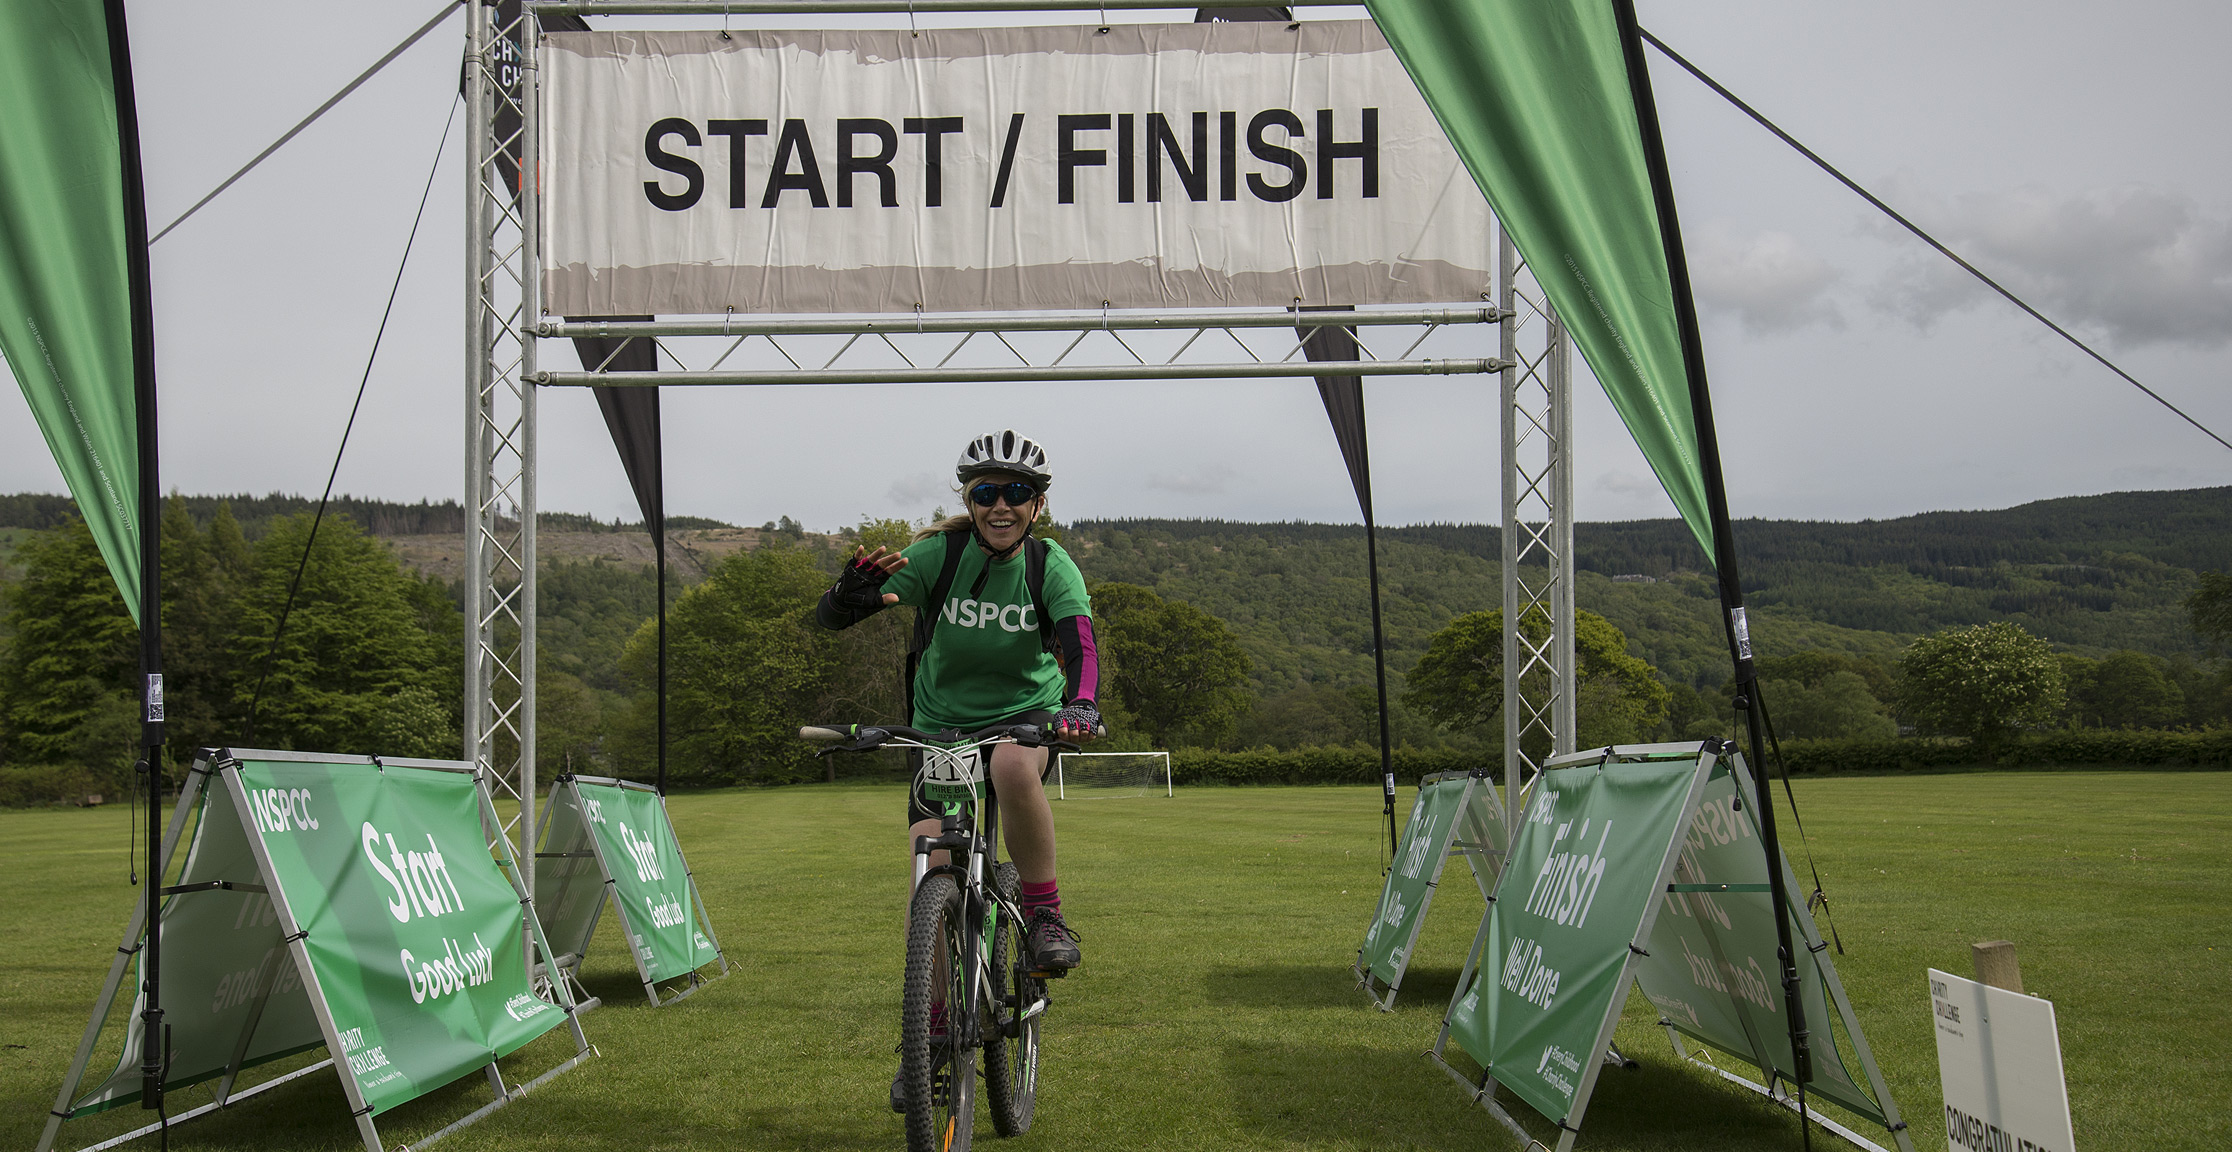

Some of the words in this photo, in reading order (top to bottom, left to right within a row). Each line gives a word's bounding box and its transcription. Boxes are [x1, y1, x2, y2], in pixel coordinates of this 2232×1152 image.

[643, 117, 964, 211] START
[990, 113, 1025, 208] /
[1057, 107, 1379, 205] FINISH
[45, 353, 61, 383] Registered
[1587, 290, 1608, 319] Registered
[1604, 317, 1618, 337] charity
[1616, 336, 1632, 359] England
[1629, 357, 1638, 370] and
[1657, 404, 1665, 417] and
[58, 381, 69, 401] charity
[67, 400, 81, 424] England
[78, 423, 87, 434] and
[83, 431, 93, 450] Wales
[90, 449, 103, 470] 216401
[100, 469, 109, 481] and
[104, 479, 120, 505] Scotland
[938, 597, 1039, 632] NSPCC
[927, 753, 977, 782] 117
[931, 785, 952, 794] HIRE
[954, 784, 976, 794] BIK
[252, 788, 319, 832] NSPCC
[1528, 791, 1560, 825] NSPCC
[620, 822, 664, 882] Start
[362, 822, 464, 923] Start
[1524, 818, 1613, 929] Finish
[646, 893, 674, 929] Good
[401, 937, 465, 1004] Good
[452, 932, 493, 986] Luck
[1501, 936, 1535, 993] Well
[1518, 945, 1560, 1010] Done
